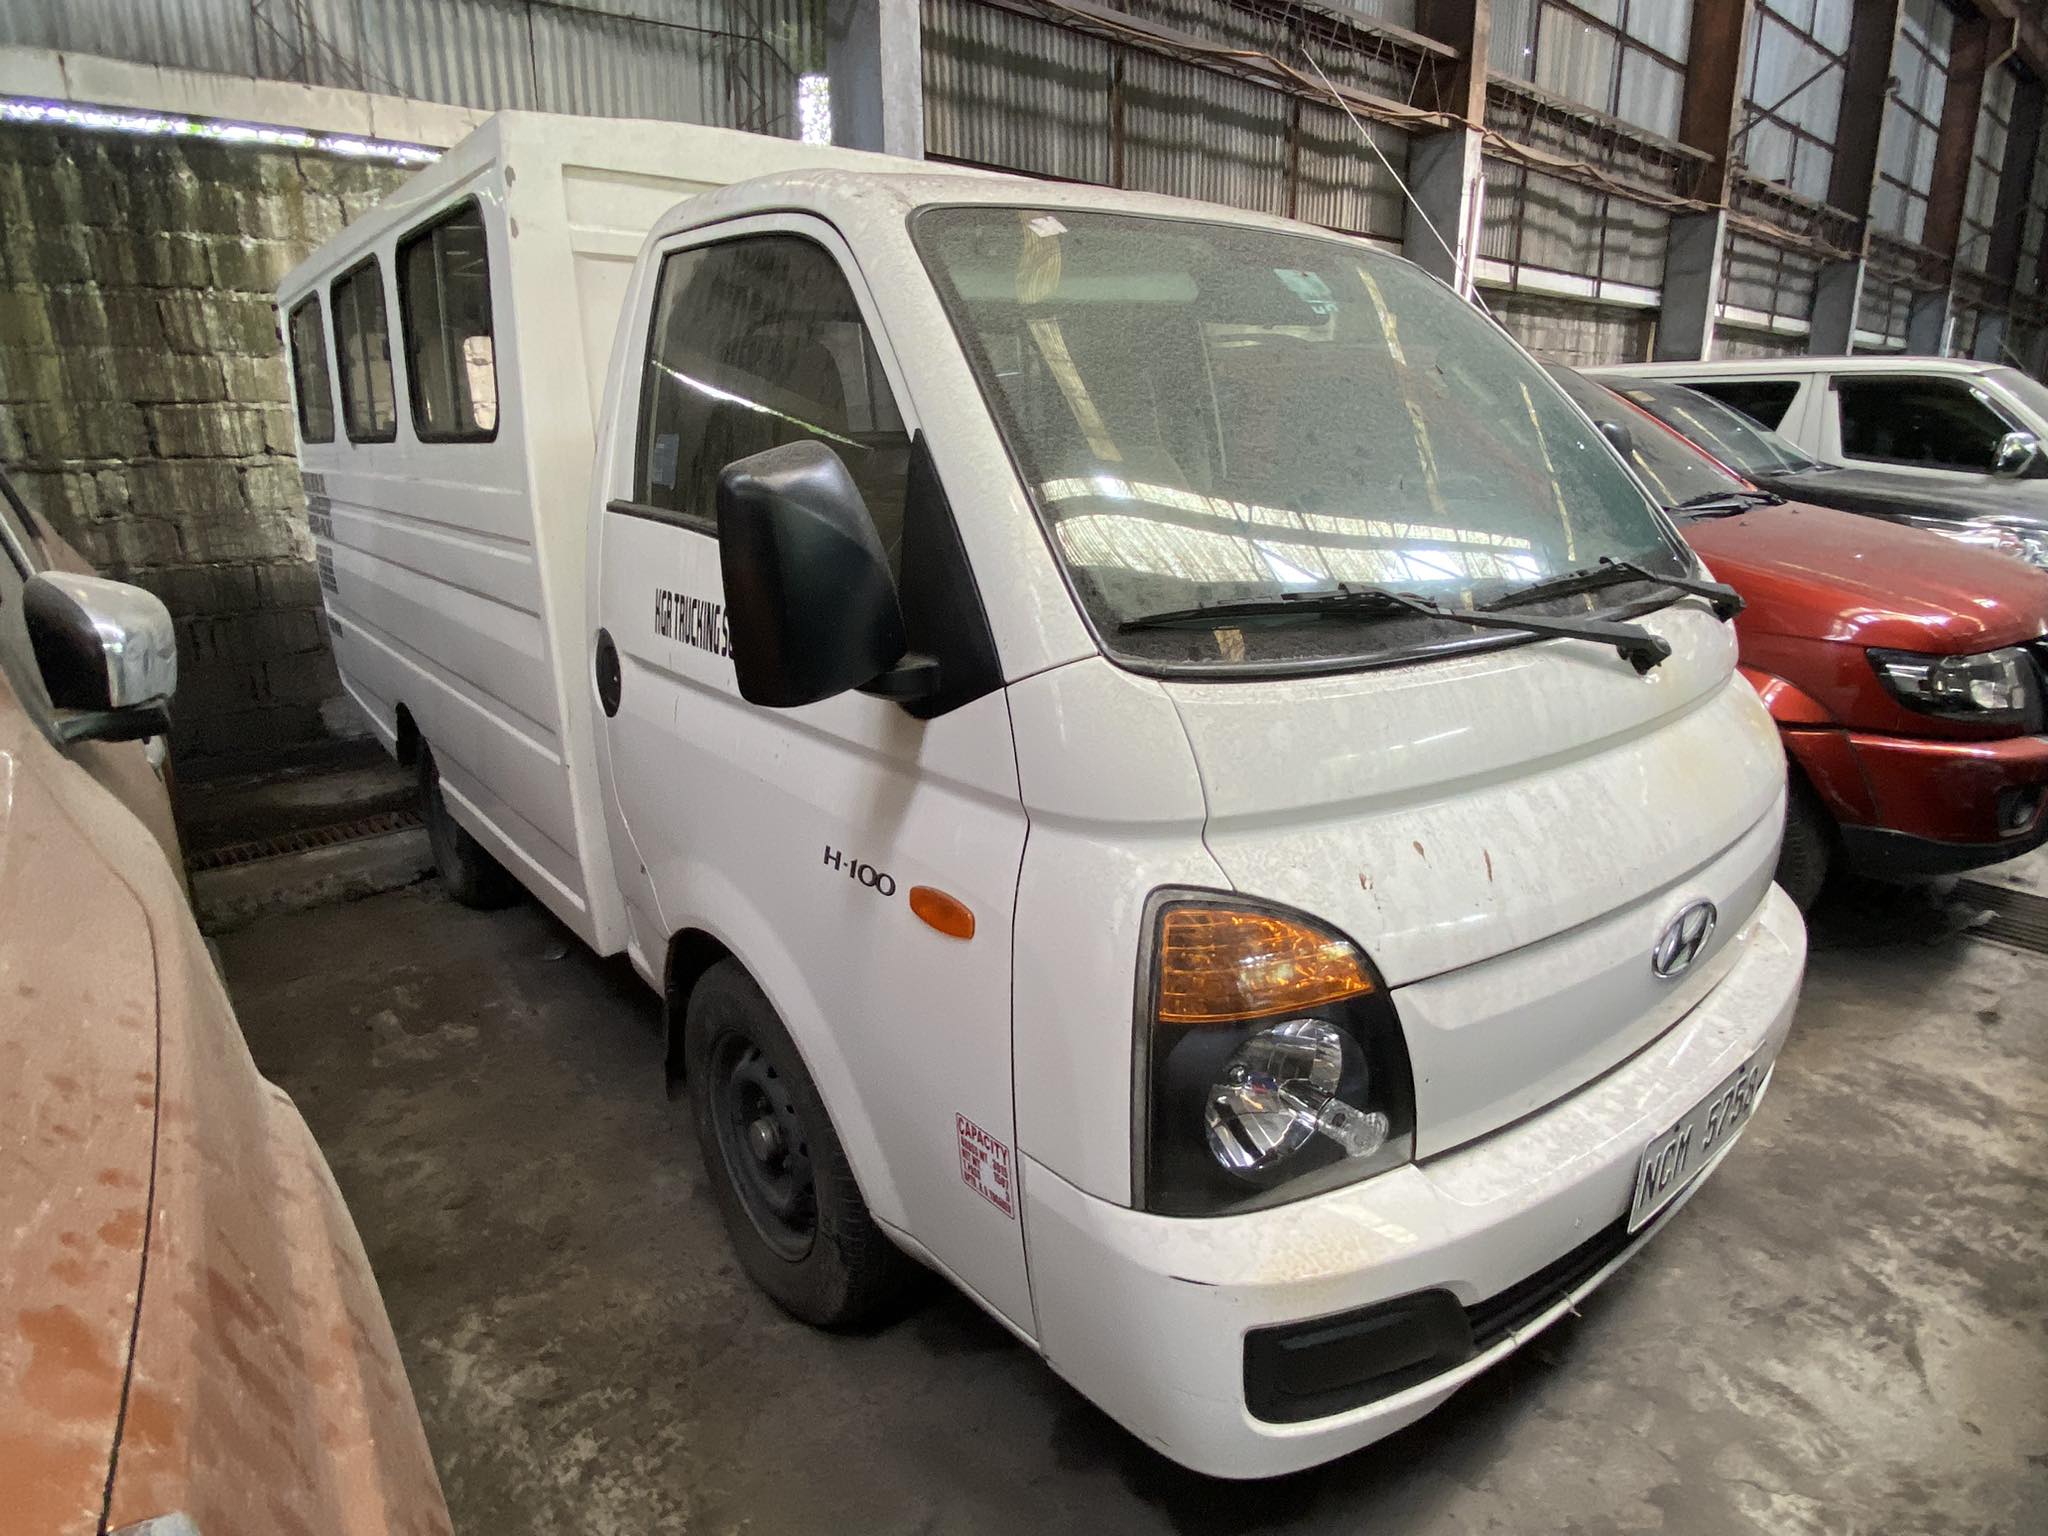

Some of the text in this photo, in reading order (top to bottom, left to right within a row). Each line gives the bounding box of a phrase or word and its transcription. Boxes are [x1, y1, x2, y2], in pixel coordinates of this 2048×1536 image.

[674, 593, 720, 654] TRUCKING
[824, 845, 896, 896] H-100
[959, 1117, 1008, 1166] CAPACITY
[1637, 1124, 1693, 1209] NCM
